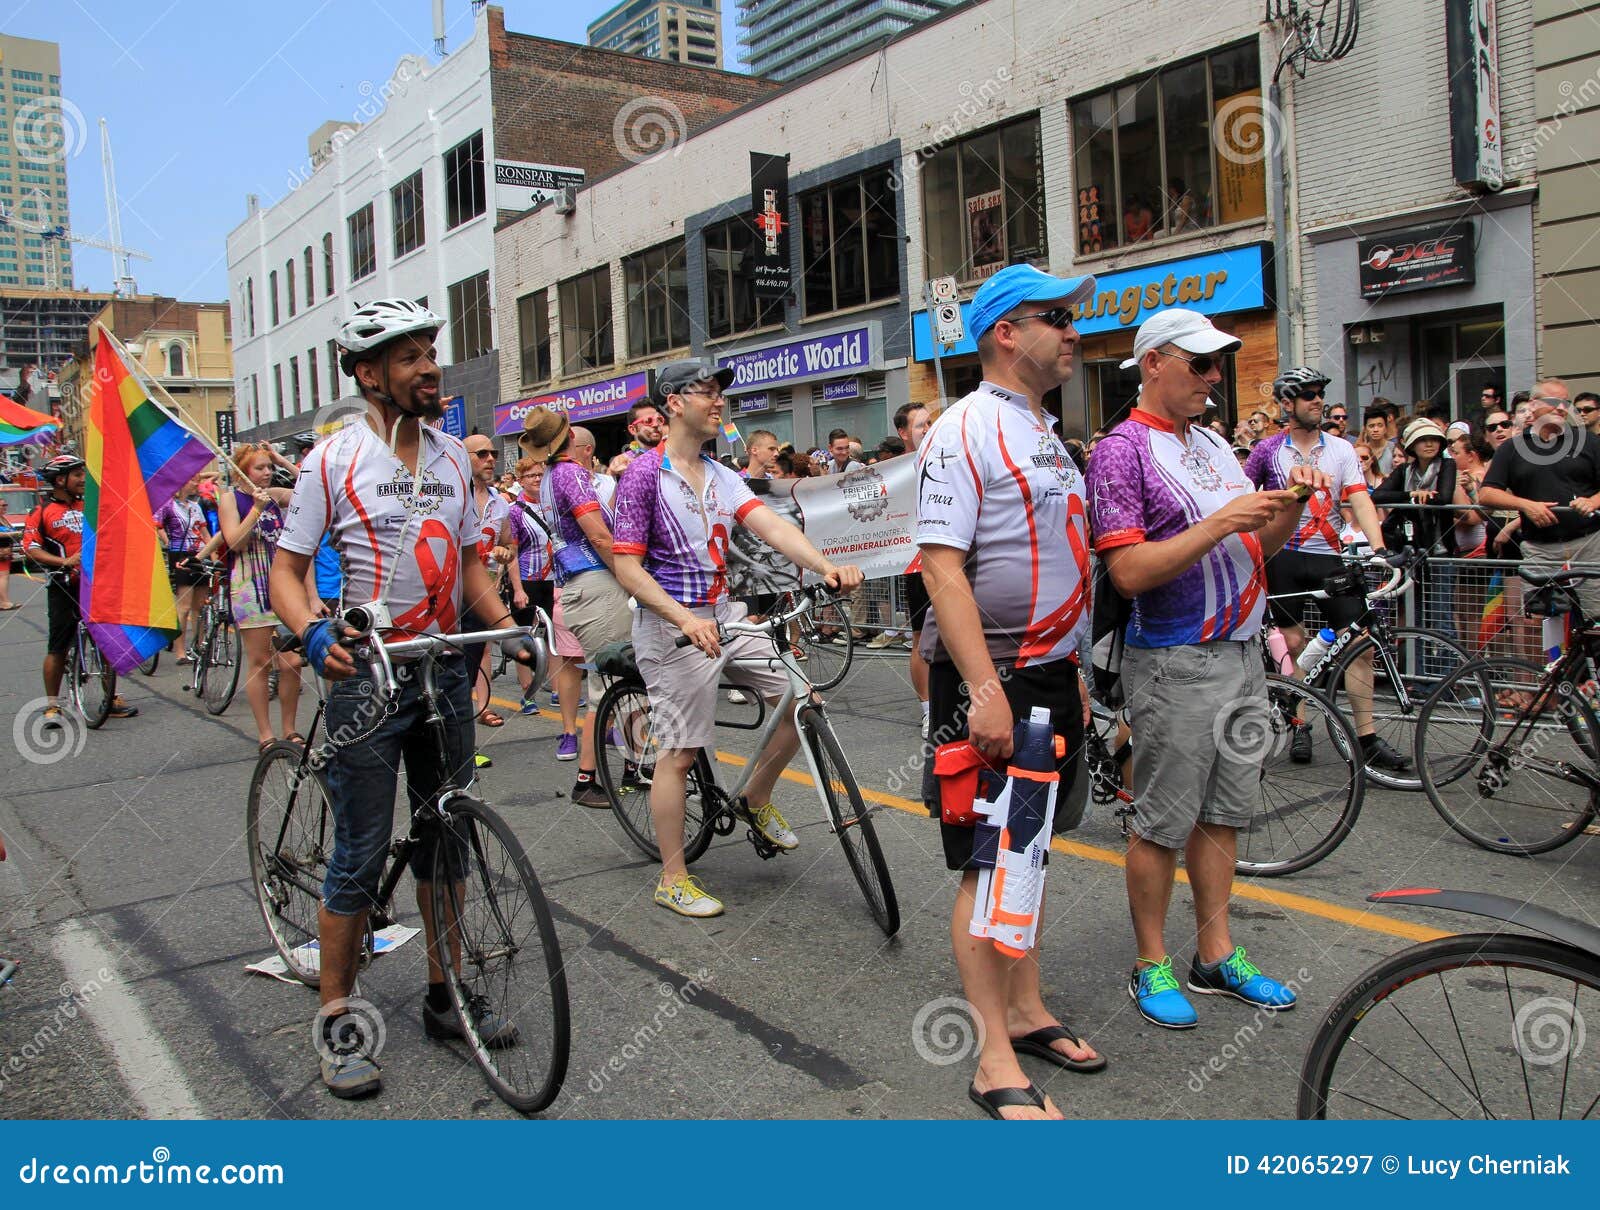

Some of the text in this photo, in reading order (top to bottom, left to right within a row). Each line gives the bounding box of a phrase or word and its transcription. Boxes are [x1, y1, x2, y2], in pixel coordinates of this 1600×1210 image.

[498, 177, 541, 187] CONSTRUCTION
[968, 197, 985, 213] safe
[803, 333, 861, 371] World
[510, 382, 627, 421] Coetic World
[378, 483, 413, 495] FRIENDS
[440, 485, 455, 497] LIFE
[843, 483, 878, 495] FRIENDS
[858, 489, 879, 500] LIFE
[823, 527, 910, 546] TORONTO TO MONTREAL
[822, 536, 912, 556] WWW.BIKERALLY.ORG
